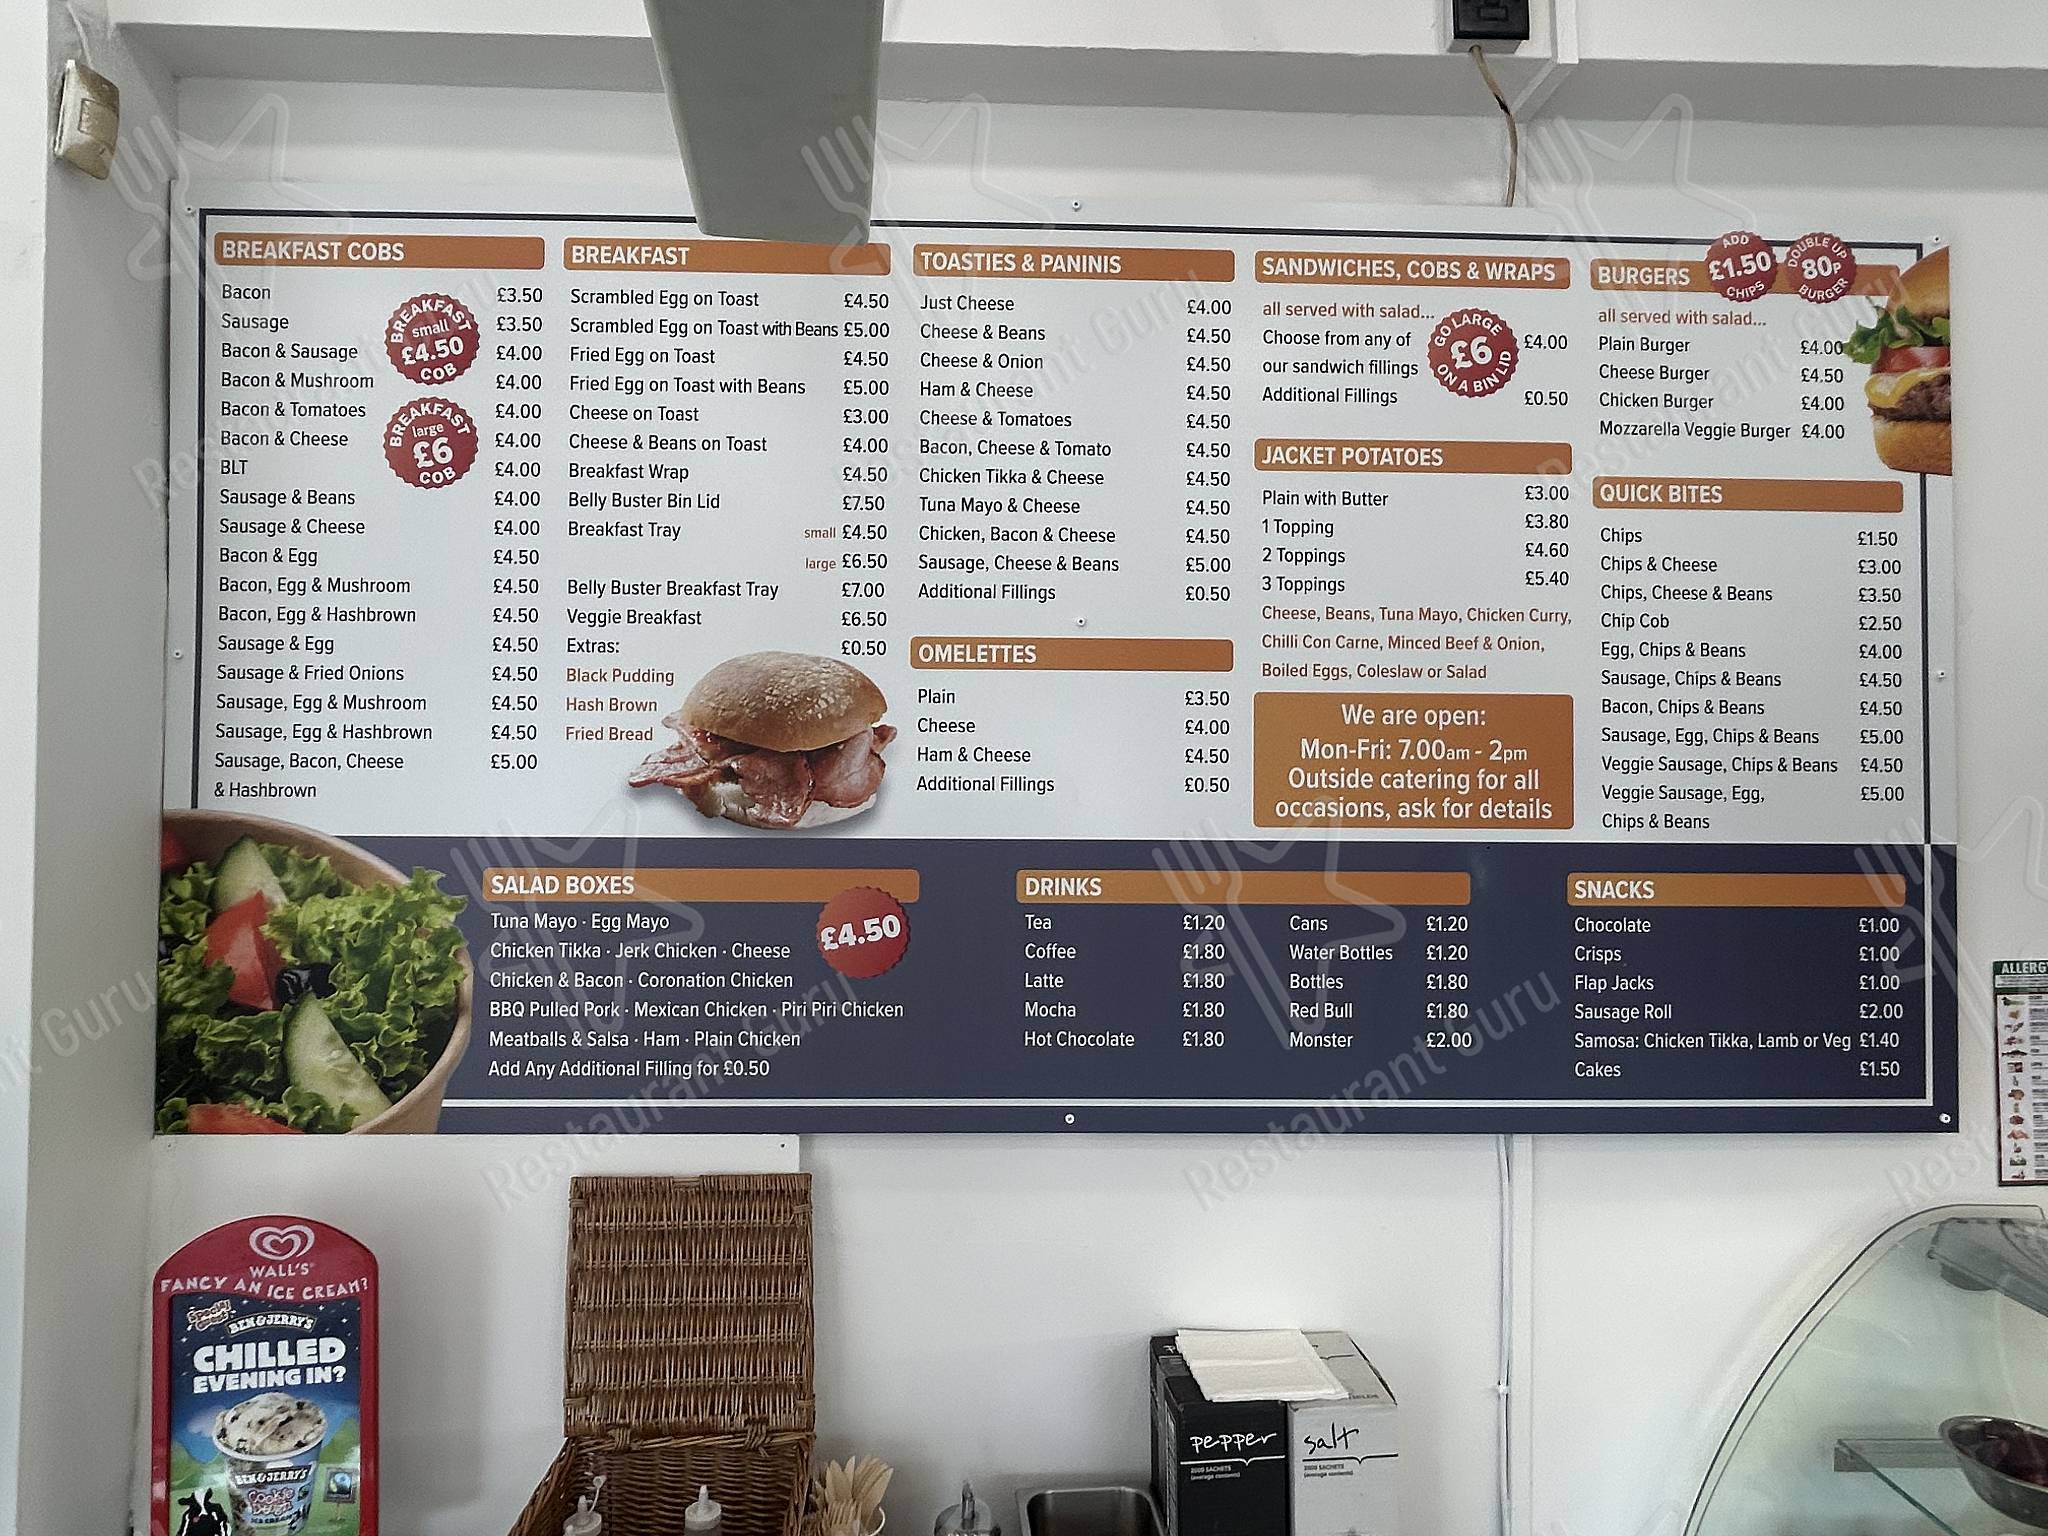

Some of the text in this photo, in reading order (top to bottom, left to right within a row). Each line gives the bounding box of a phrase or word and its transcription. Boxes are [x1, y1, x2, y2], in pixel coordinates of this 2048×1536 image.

[222, 240, 404, 261] BREAKFAST COBS
[1722, 234, 1749, 249] ADD
[572, 245, 690, 265] BREAKFAST
[920, 251, 1121, 273] TOASTIES & PANINIS
[1788, 236, 1847, 268] DOUBLE UP
[1262, 257, 1555, 281] SANDWICHES, COBS & WRAPS
[1598, 266, 1690, 286] BURGERS
[1708, 251, 1772, 281] £1.50
[1726, 280, 1765, 299] CHIPS
[1799, 277, 1849, 301] BURGER
[1262, 301, 1434, 319] all served with salad...
[390, 298, 472, 344] BREAKFAST
[412, 319, 450, 338] small
[1434, 313, 1503, 347] GO LARGE
[401, 336, 464, 366] £4.50
[1450, 336, 1493, 370] £6
[221, 371, 542, 390] Bacon & Mushroom £4.00
[420, 363, 457, 380] COB
[1437, 350, 1512, 392] ON A BIN LID
[389, 402, 471, 447] BREAKFAST
[412, 423, 444, 438] large
[1600, 420, 1845, 441] Mozzarella Veggie Burger £4.00
[413, 436, 453, 469] £6
[1261, 445, 1443, 466] JACKET POTATOES
[419, 466, 456, 484] COB
[568, 491, 884, 511] Belly Buster Bin Lid £7.50
[1600, 483, 1722, 503] QUICK BITES
[804, 524, 887, 540] small £4.50
[1600, 527, 1898, 546] Chips £1.50
[805, 553, 888, 572] large £6.50
[1262, 570, 1569, 595] 3 Toppings £5.40
[918, 644, 1036, 663] OMELETTES
[1601, 641, 1902, 660] Egg, Chips & Beans £4.00
[216, 664, 538, 684] Sausage & Fried Onions £4.50
[566, 667, 674, 686] Black Pudding
[1341, 703, 1485, 730] We are open:
[1301, 738, 1391, 760] Mon-Fri:
[1398, 738, 1470, 760] 7.00am
[1489, 739, 1527, 764] 2pm
[916, 775, 1230, 795] Additional Fillings £0.50
[1288, 766, 1538, 794] Outside catering for all
[1275, 796, 1552, 821] occasions, ask for details
[491, 875, 634, 894] SALAD BOXES
[1026, 877, 1102, 896] DRINKS
[1574, 880, 1654, 899] SNACKS
[1024, 914, 1225, 930] Tea £1.20
[820, 913, 902, 952] £4.50
[1289, 944, 1468, 961] Water Bottles £1.20
[1575, 974, 1900, 993] Flap Jacks £1.00
[1024, 1030, 1224, 1047] Hot Chocolate £1.80
[1574, 1032, 1899, 1051] Samosa: Chicken Tikka, Lamb or Veg £1.40
[488, 1060, 770, 1080] Add Any Additional Filling for £0.50
[249, 1262, 310, 1278] WALL'S
[160, 1276, 369, 1300] FANCY AN ICE CREAM?
[193, 1337, 347, 1374] CHILLED
[193, 1365, 347, 1395] EVENING IN?
[1190, 1432, 1277, 1454] pepper
[1304, 1422, 1359, 1455] salt
